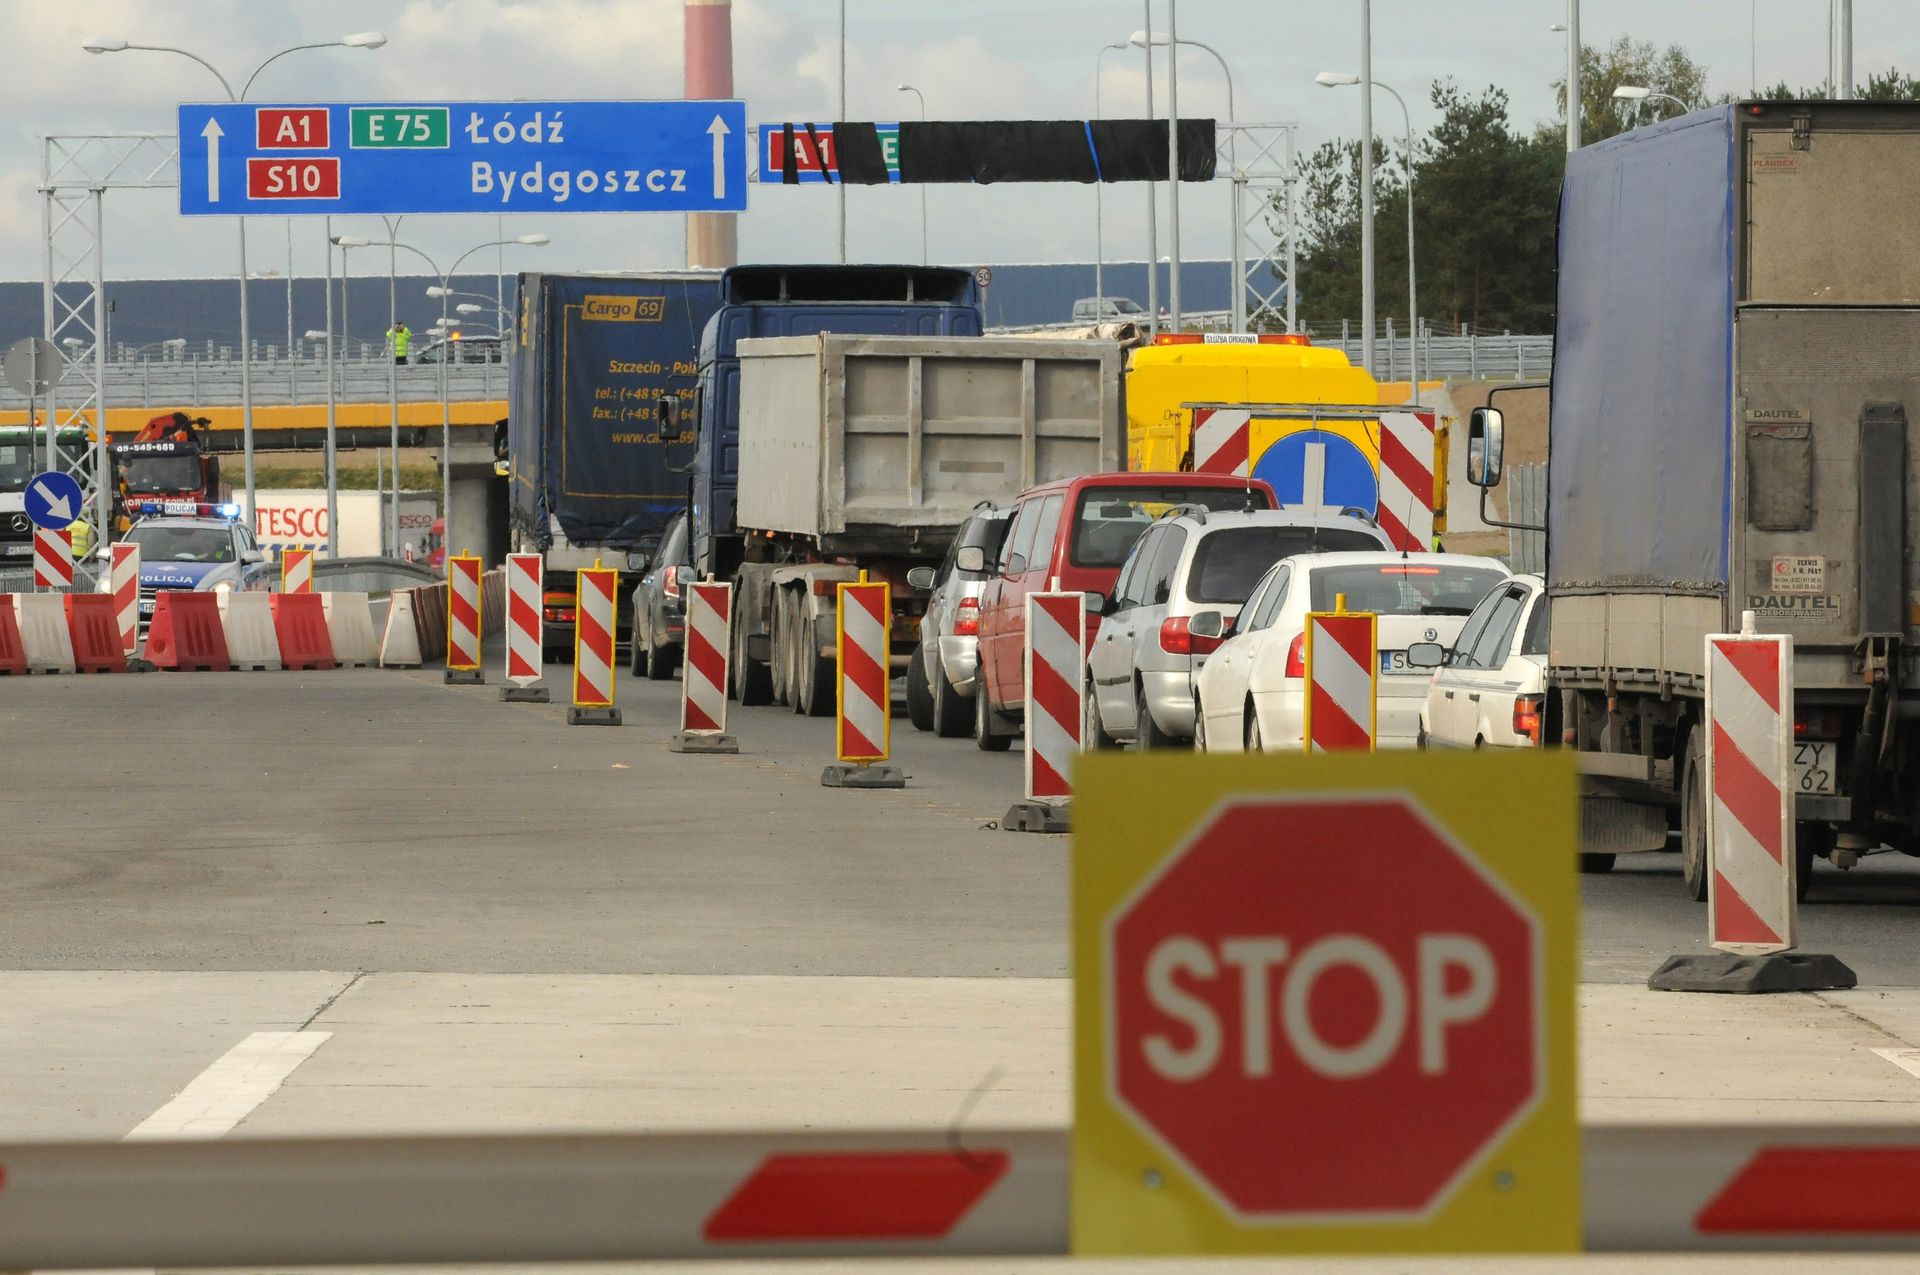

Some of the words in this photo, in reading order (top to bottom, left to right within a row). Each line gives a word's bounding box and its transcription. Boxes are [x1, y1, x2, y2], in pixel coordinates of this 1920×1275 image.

[276, 116, 310, 142] A1
[369, 115, 385, 141] E
[394, 115, 431, 141] 75
[465, 112, 564, 144] Łódź
[794, 138, 828, 165] A1
[882, 138, 898, 163] E
[266, 166, 321, 193] S10
[472, 161, 686, 203] Bydgoszcz
[978, 272, 990, 282] 50
[587, 300, 631, 318] Cargo
[638, 302, 659, 316] 69
[1228, 334, 1257, 344] DROGOWA
[608, 360, 661, 374] Szczecin
[595, 387, 617, 400] tel.:
[620, 387, 649, 402] (+48
[592, 406, 617, 419] fax.:
[620, 407, 650, 422] (+48
[1753, 410, 1802, 418] DAUTEL
[165, 504, 196, 512] POLICJA
[399, 514, 432, 524] ESCO
[141, 575, 193, 584] OLICJA
[1749, 595, 1838, 609] DAUTEL
[1755, 609, 1823, 617] ADEBORDWAND
[1794, 743, 1825, 765] ZY
[1799, 769, 1829, 791] 62
[1140, 933, 1498, 1083] STOP
